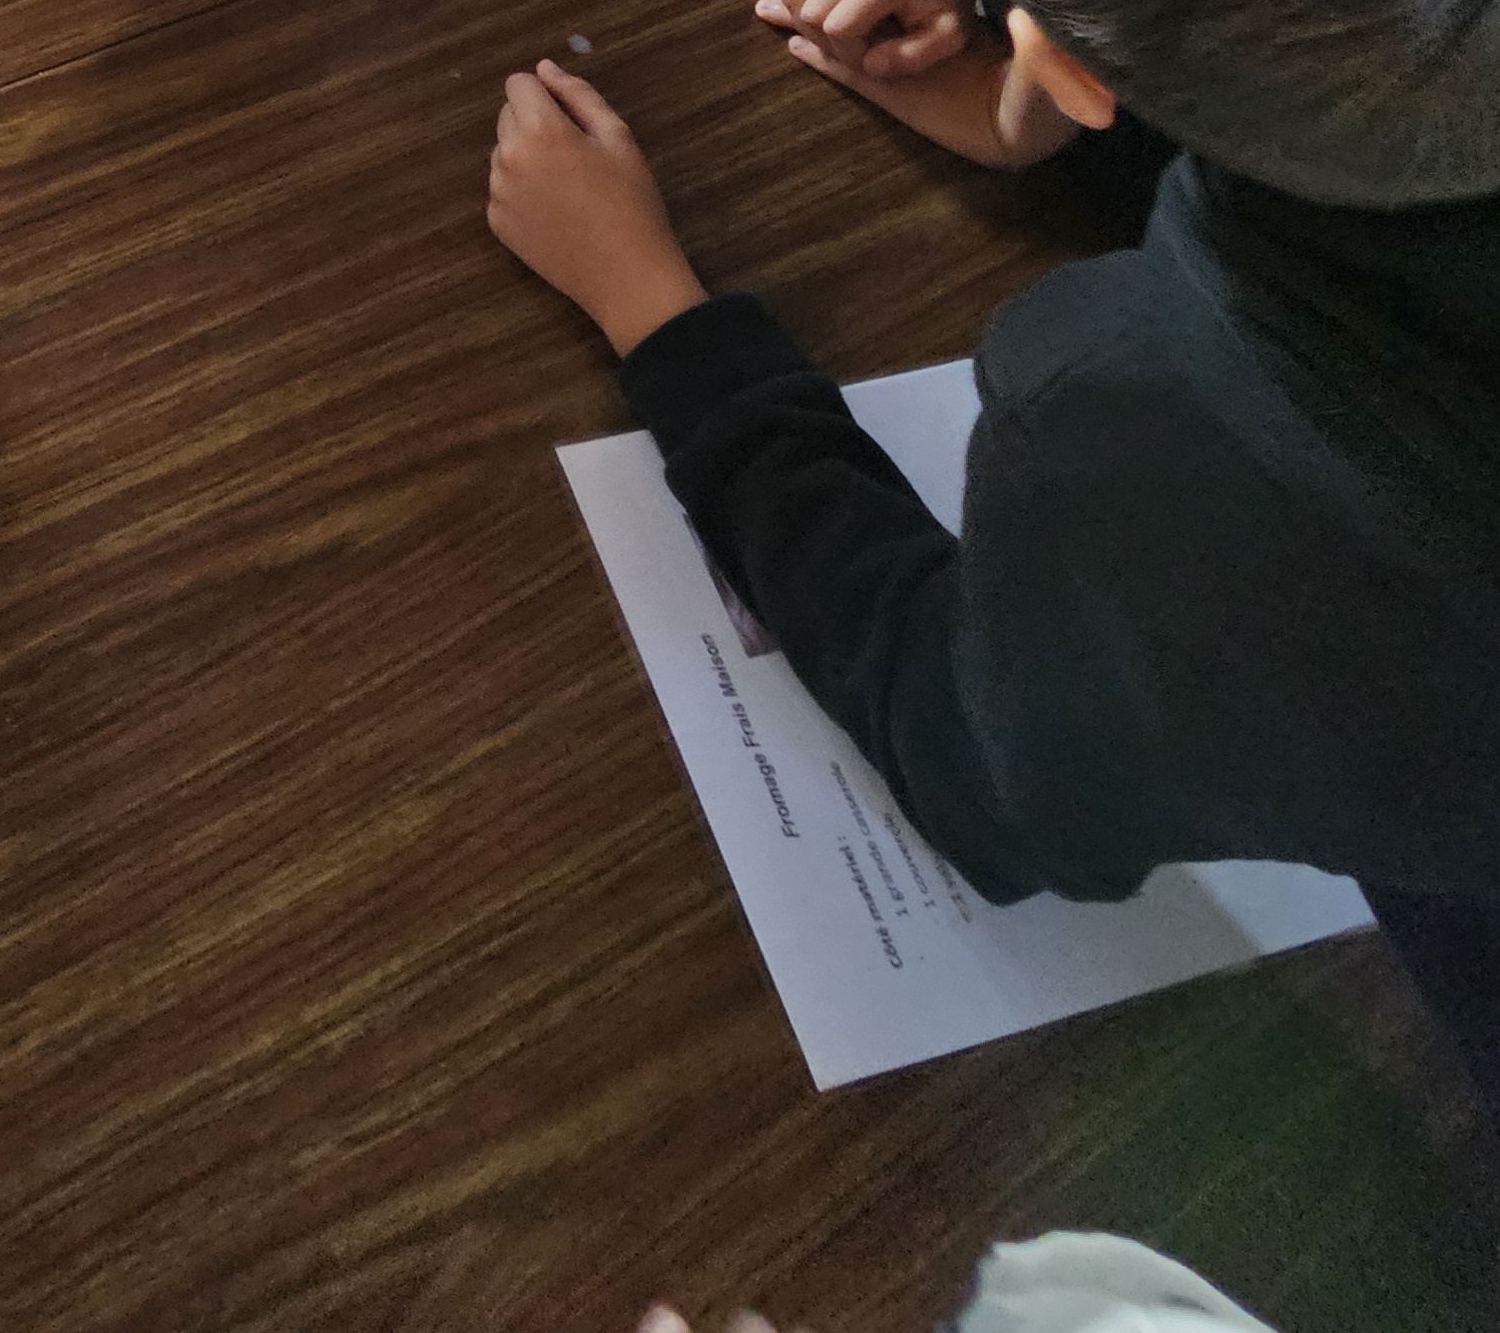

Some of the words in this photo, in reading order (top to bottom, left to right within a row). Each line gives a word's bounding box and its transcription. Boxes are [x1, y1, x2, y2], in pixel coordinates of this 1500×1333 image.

[700, 633, 738, 698] Maison
[732, 701, 761, 748] Frais
[753, 751, 800, 839] Fromage
[839, 844, 883, 922] matériel
[866, 839, 905, 902] grande
